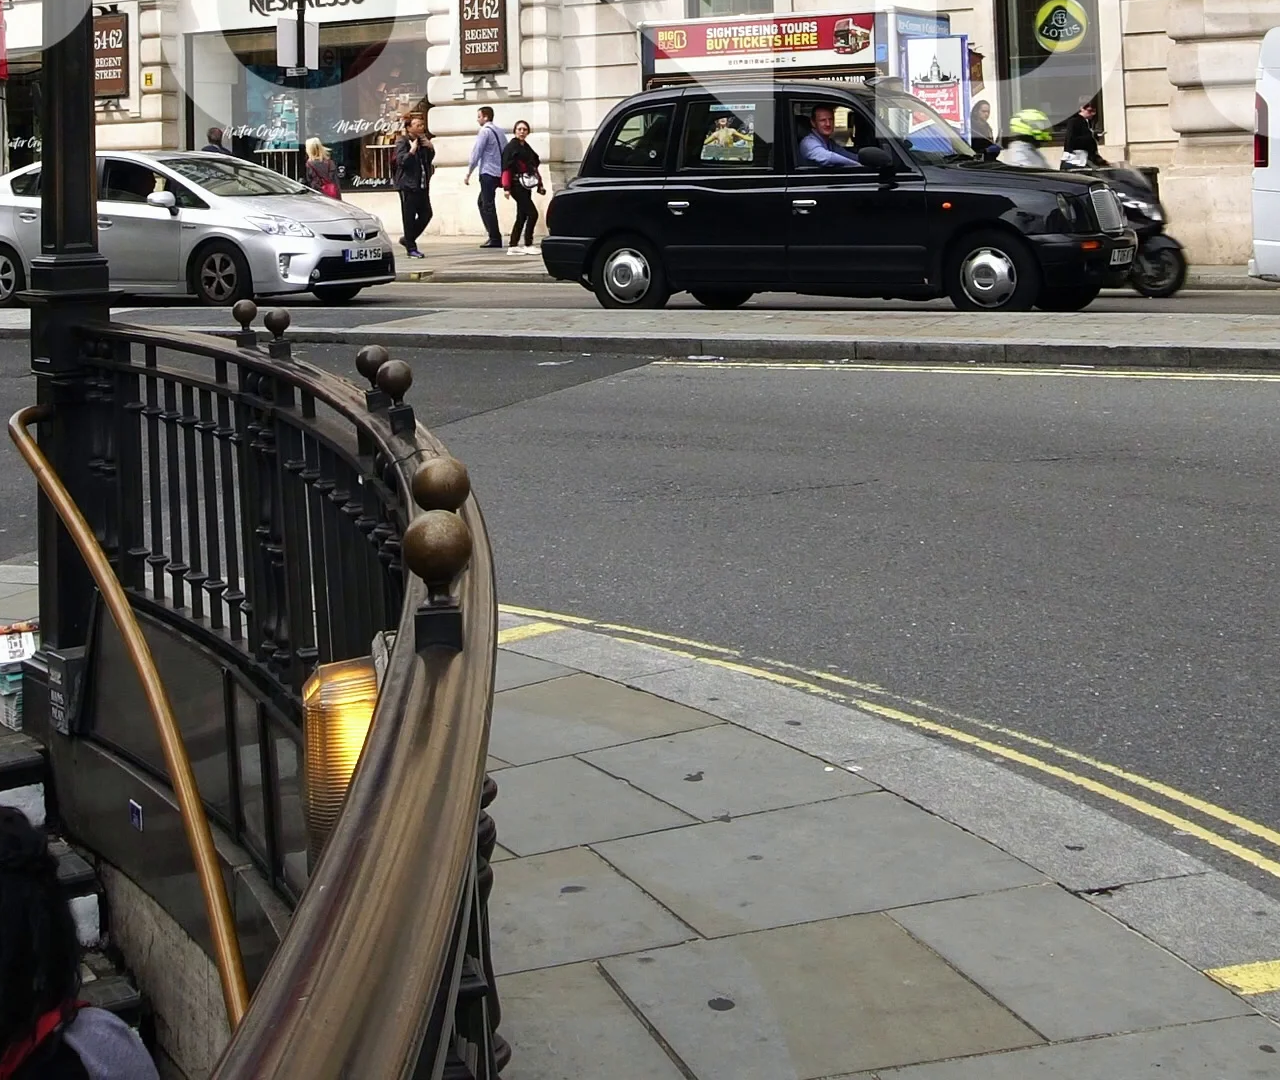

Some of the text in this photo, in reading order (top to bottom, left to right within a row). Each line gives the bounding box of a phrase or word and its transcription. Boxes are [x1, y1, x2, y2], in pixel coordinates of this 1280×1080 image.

[465, 28, 499, 41] REGENT
[658, 31, 674, 40] BIG
[706, 21, 818, 39] SIGHTSEEING TOURS
[1042, 24, 1081, 38] LOTUS
[94, 29, 123, 50] 54-62
[659, 40, 675, 50] BUS
[706, 37, 729, 51] BUY
[732, 34, 782, 49] TICKETS
[785, 32, 818, 46] HERE
[465, 41, 499, 54] STREET
[95, 57, 122, 68] REGENT
[95, 69, 122, 80] STREET
